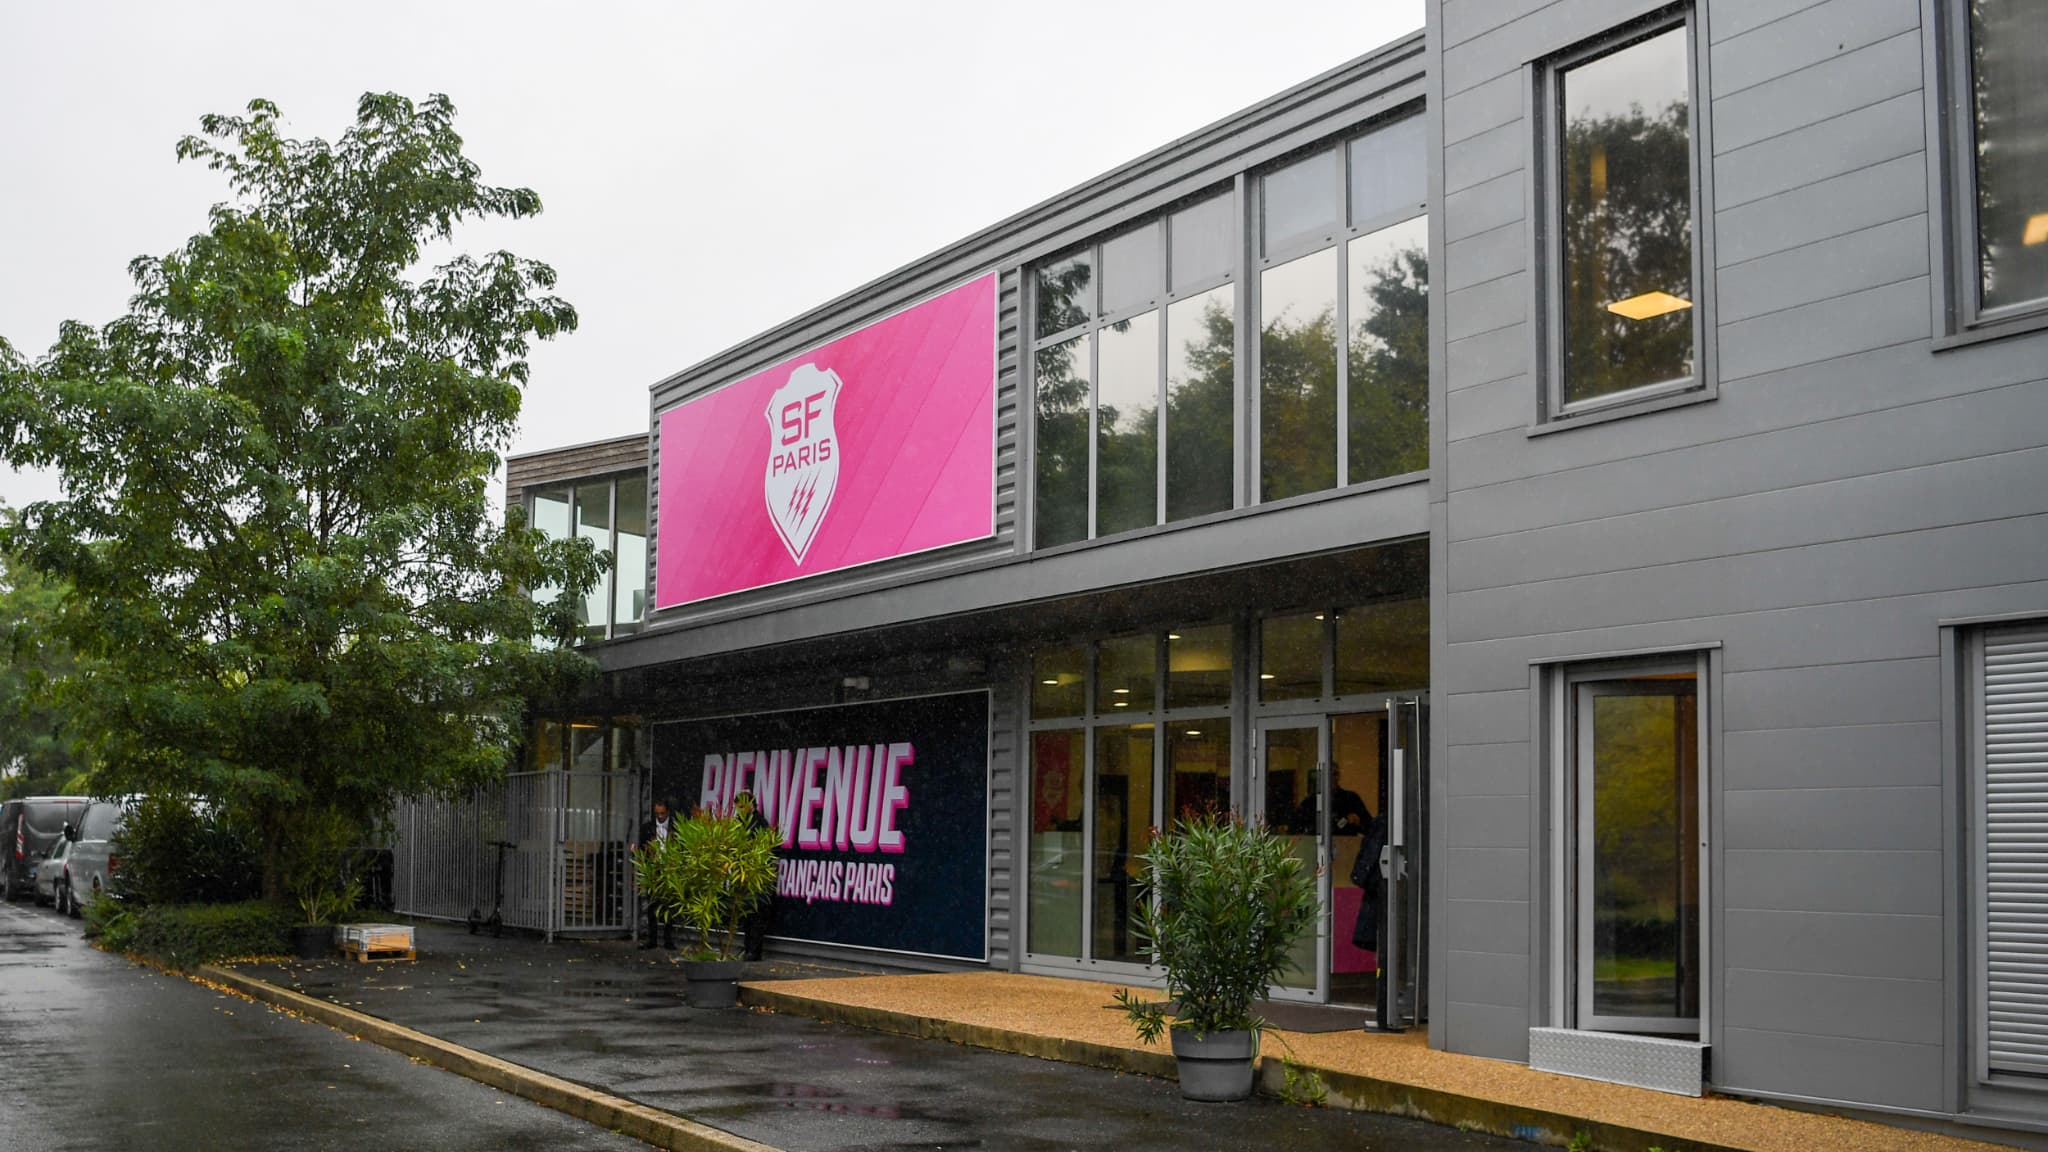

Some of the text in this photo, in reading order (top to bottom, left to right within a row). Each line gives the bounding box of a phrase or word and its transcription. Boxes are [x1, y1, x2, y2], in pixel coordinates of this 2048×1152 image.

[782, 391, 826, 445] SF
[773, 438, 830, 477] PARIS
[773, 858, 895, 906] RANÇAIS PARIS
